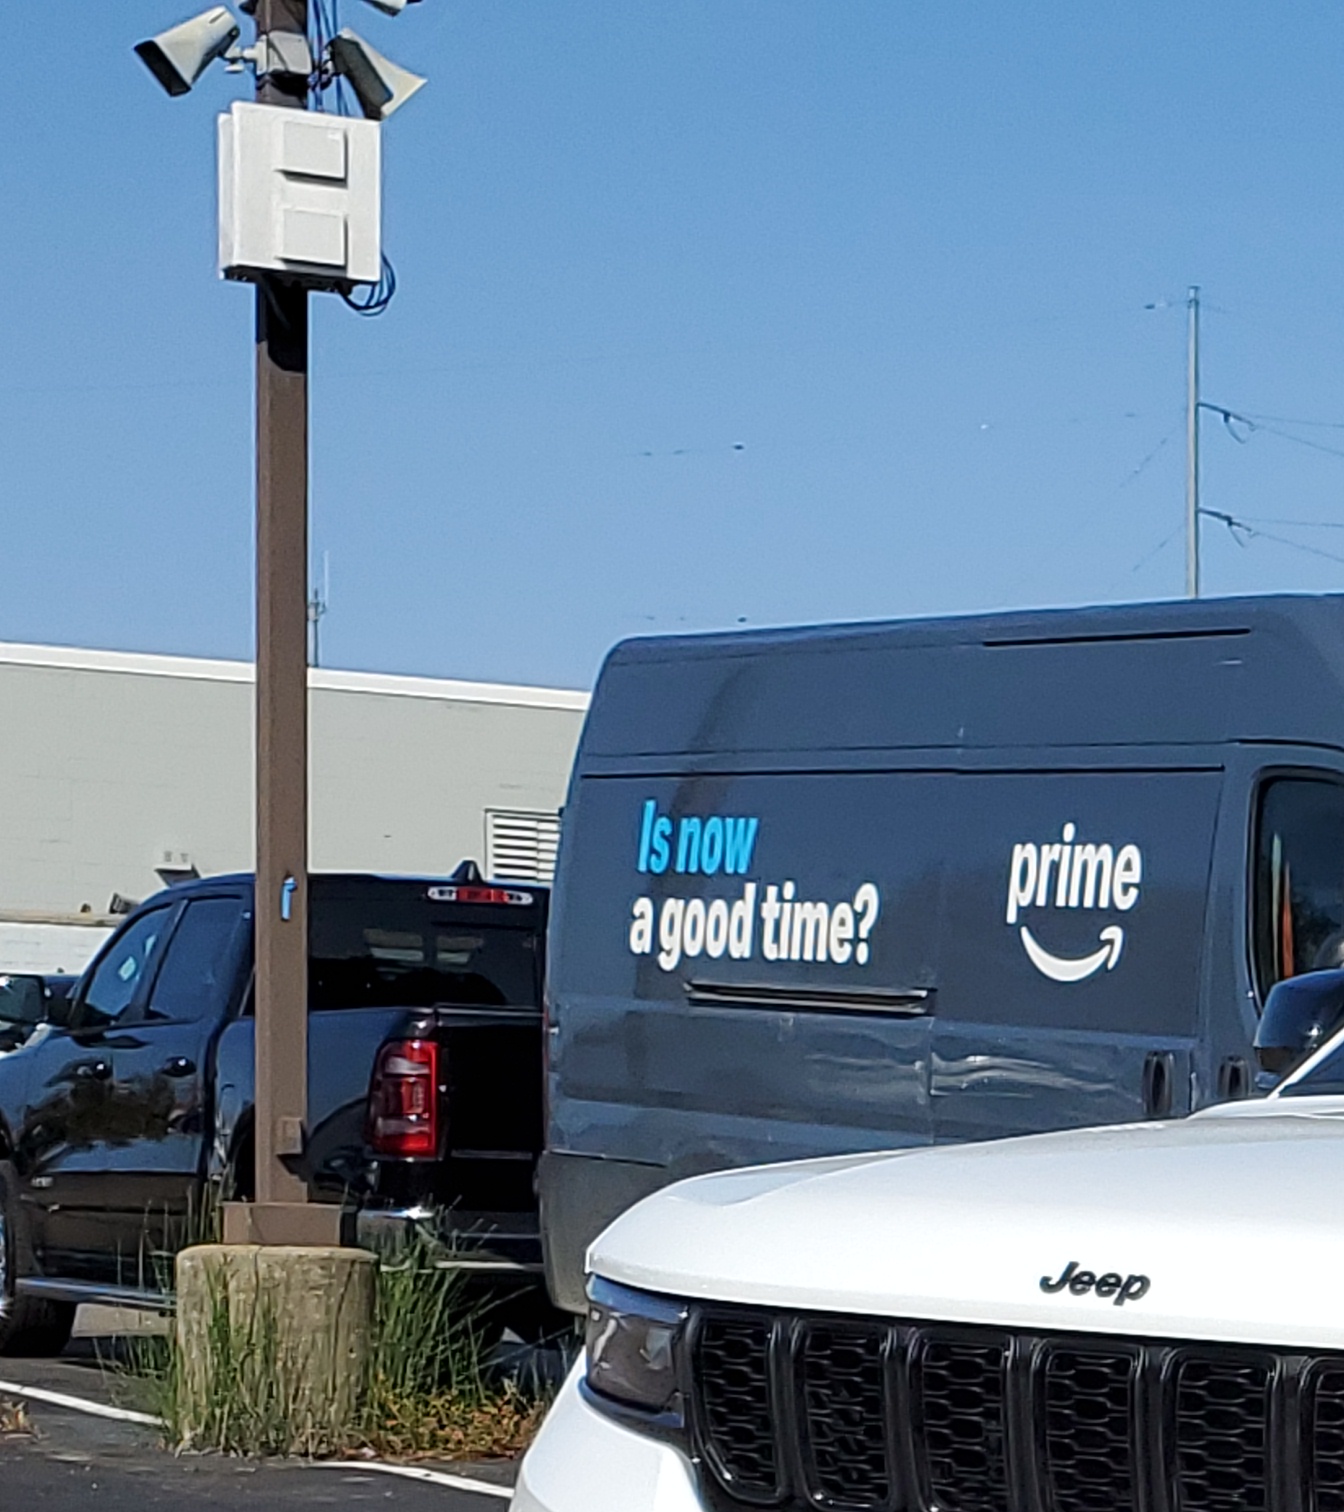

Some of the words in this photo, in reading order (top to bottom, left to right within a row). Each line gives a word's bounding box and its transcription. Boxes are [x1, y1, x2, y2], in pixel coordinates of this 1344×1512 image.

[637, 799, 673, 875] Is
[675, 816, 759, 876] now
[1006, 823, 1142, 924] prime
[629, 897, 652, 954] a
[657, 883, 757, 972] good
[760, 881, 880, 966] time?
[1039, 1261, 1152, 1307] Jeep
